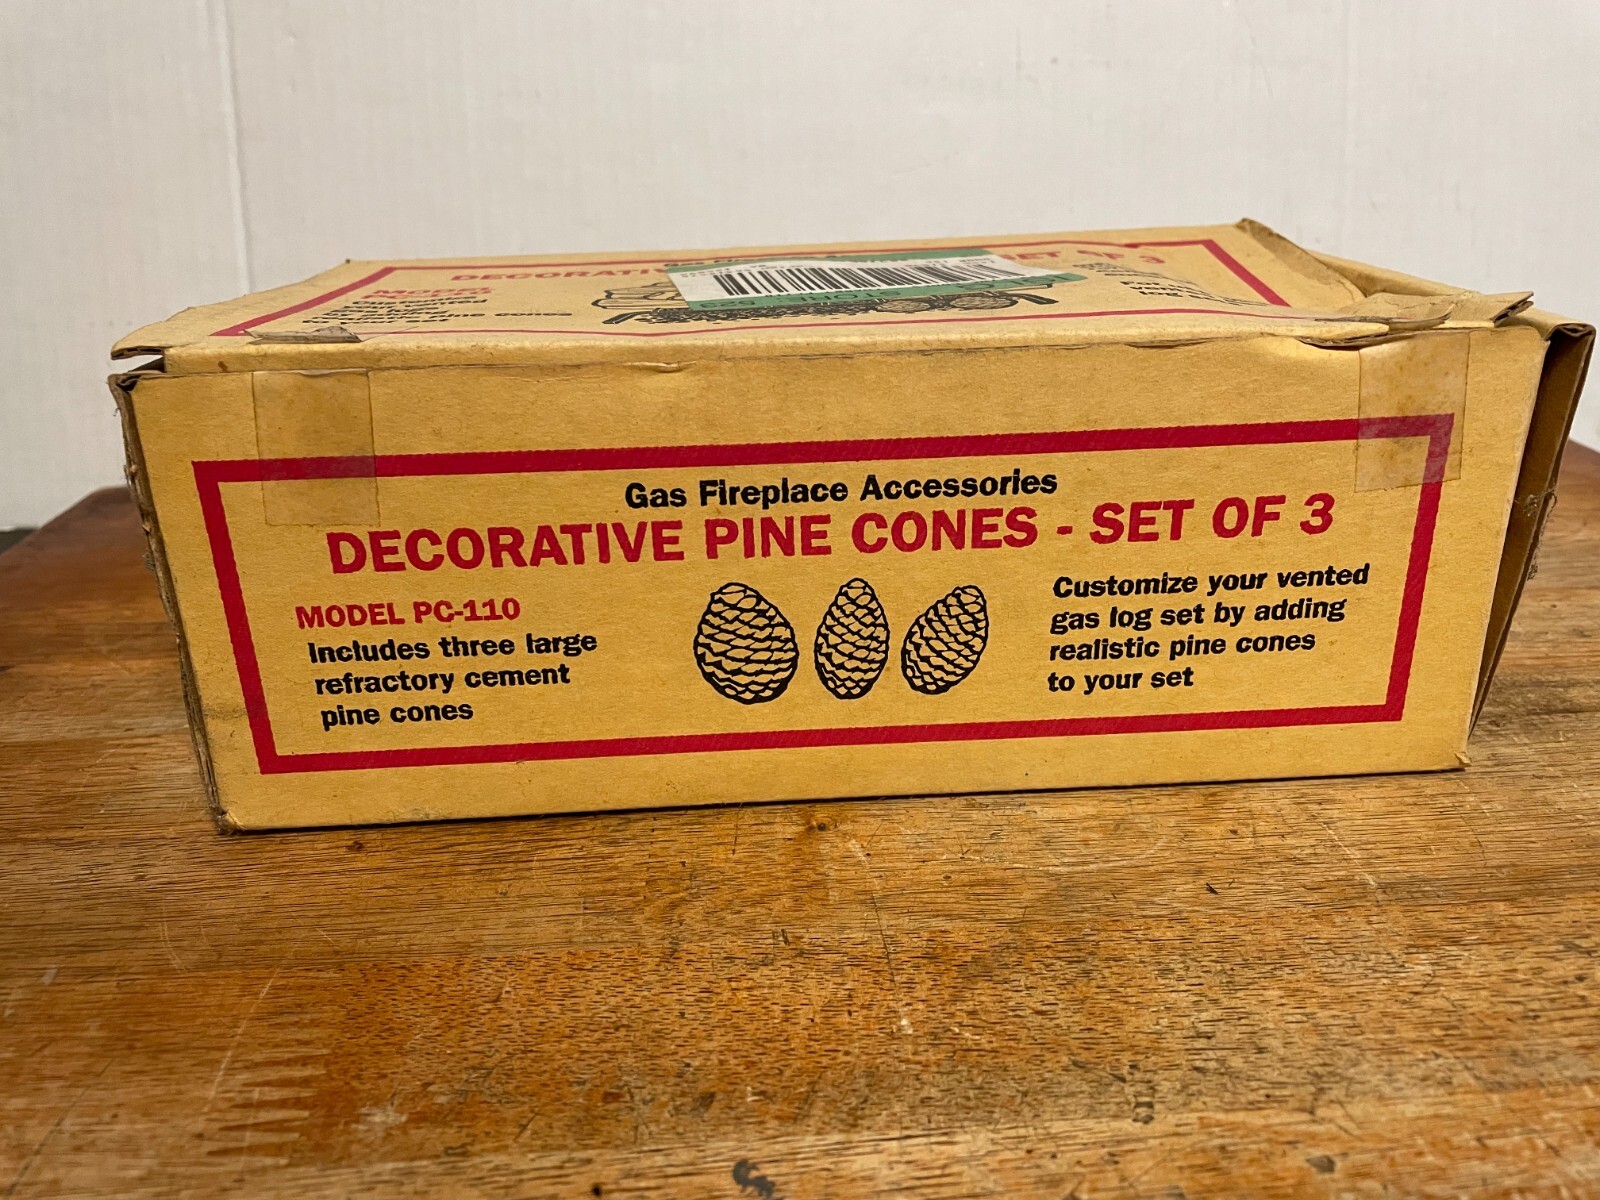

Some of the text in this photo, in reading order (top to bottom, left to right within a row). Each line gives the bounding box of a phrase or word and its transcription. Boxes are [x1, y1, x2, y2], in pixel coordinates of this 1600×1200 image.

[451, 268, 667, 281] DECORATIV
[625, 469, 1057, 509] Gas Fireplace Accessories
[326, 493, 1335, 574] DECORATIVE PINE CONES - SET OF 3
[1053, 563, 1370, 598] Customize your vented
[296, 598, 520, 629] MODEL PC-110
[1050, 598, 1347, 635] gas log set by adding
[308, 633, 597, 663] Includes three large
[1050, 634, 1315, 661] realistic pine cones
[315, 664, 570, 694] refractory cement
[1048, 667, 1193, 695] to your set
[321, 704, 473, 731] pine cones
